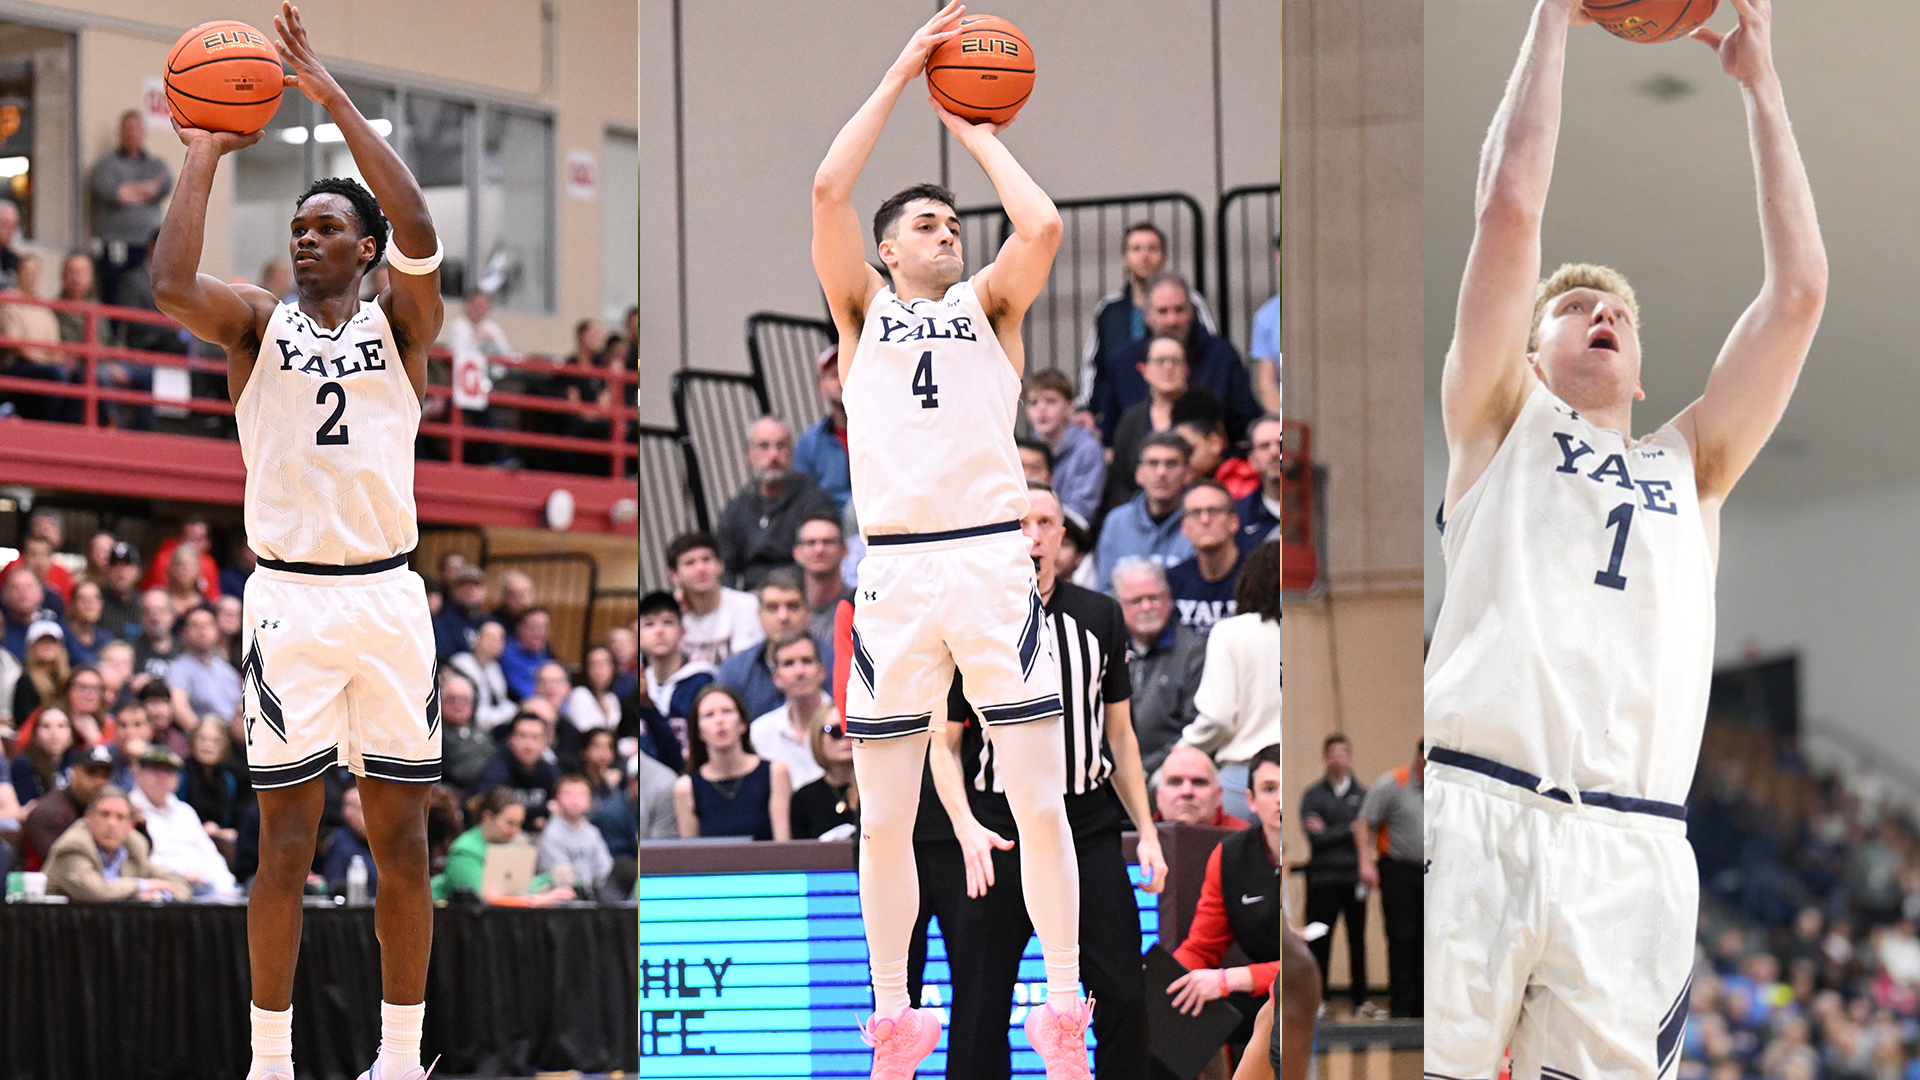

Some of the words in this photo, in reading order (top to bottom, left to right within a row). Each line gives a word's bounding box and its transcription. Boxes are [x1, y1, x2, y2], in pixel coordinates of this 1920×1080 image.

[202, 31, 265, 49] ELITE
[961, 38, 1019, 57] ELITE
[879, 316, 977, 343] YALE
[276, 339, 386, 378] YALE
[912, 350, 939, 409] 4
[315, 381, 349, 445] 2
[1552, 431, 1678, 515] YAE
[1594, 502, 1635, 591] 1
